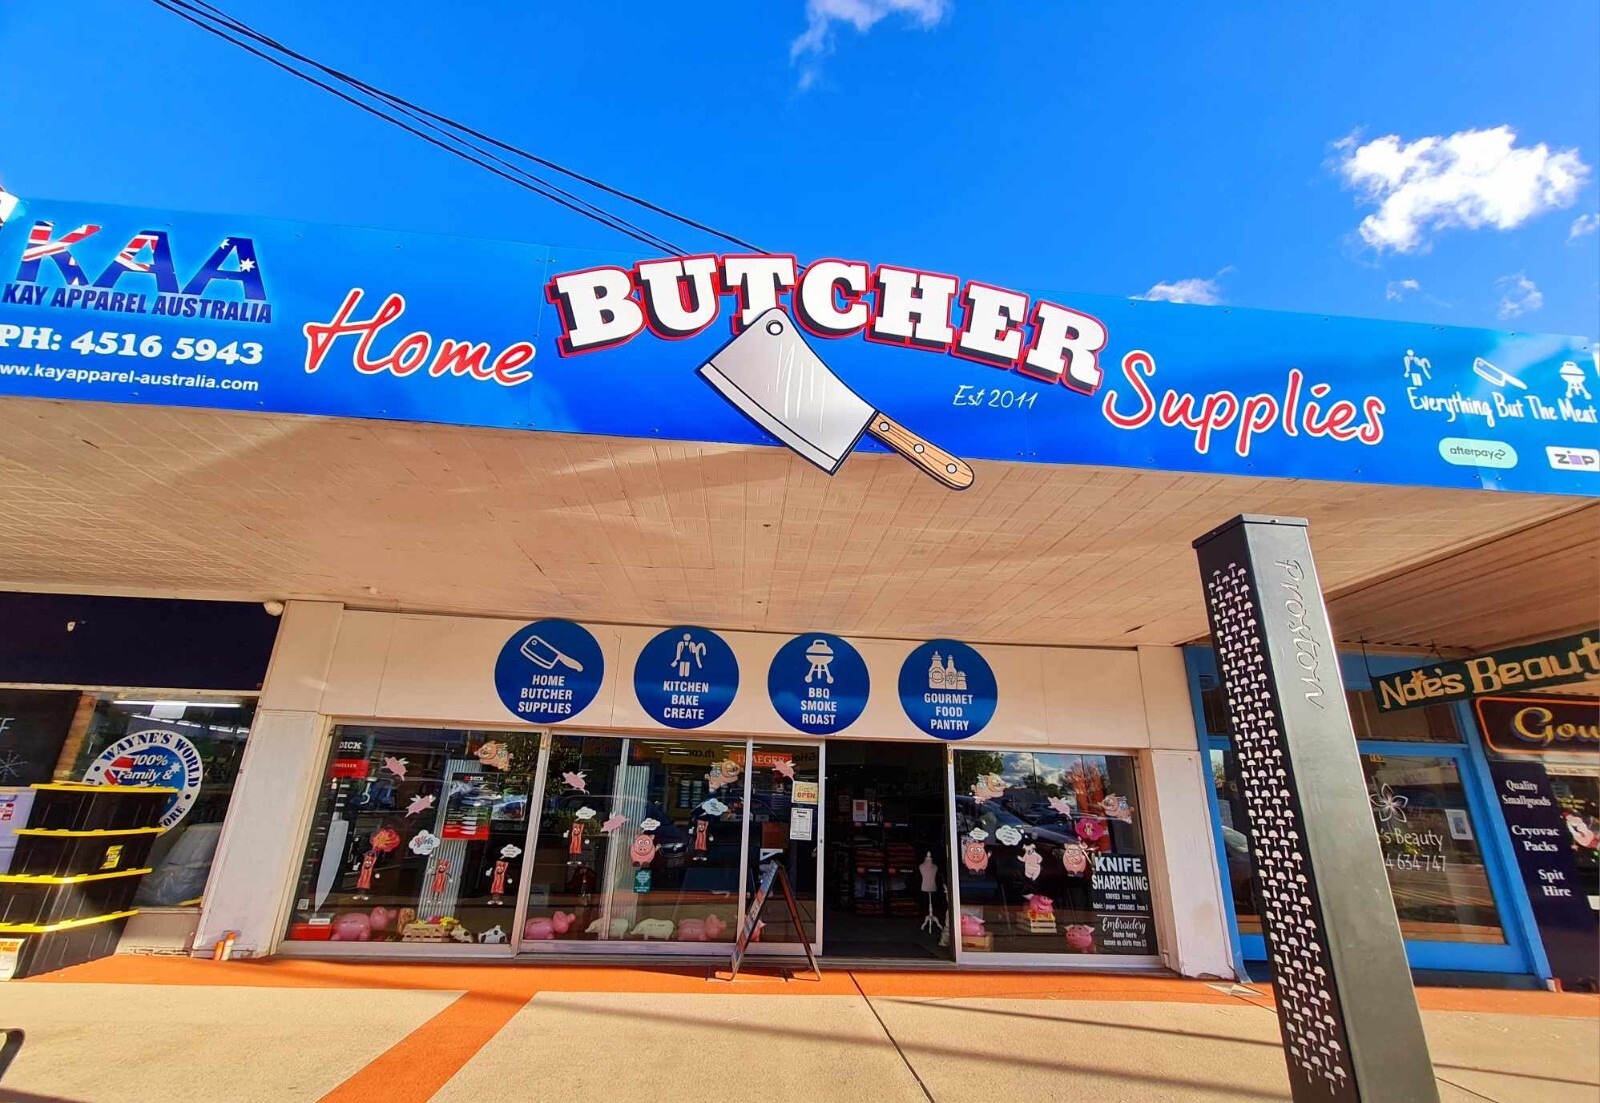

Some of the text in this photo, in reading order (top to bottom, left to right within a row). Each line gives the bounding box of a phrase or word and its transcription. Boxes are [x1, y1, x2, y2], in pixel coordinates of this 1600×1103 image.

[16, 220, 267, 300] KAA
[3, 284, 272, 324] KAY APPAREL AUSTRALIA
[0, 324, 263, 365] PH: 4516 5943
[303, 254, 1386, 457] Home BUTCHER Supplies
[953, 385, 1038, 409] Est 2011
[1407, 387, 1599, 428] Everything But The Meat
[1450, 446, 1495, 458] afterpay
[532, 674, 566, 687] HOME
[663, 680, 709, 693] KITCHEN
[520, 687, 572, 701] BUTCHER
[808, 687, 830, 700] BBQ
[1379, 667, 1465, 709] Nae's
[671, 694, 699, 706] BAKE
[923, 692, 974, 705] GOURMET
[518, 701, 572, 714] SUPPLIES
[800, 700, 837, 712] SMOKE
[935, 706, 963, 717] FOOD
[663, 707, 705, 720] CREATE
[801, 713, 836, 725] ROAST
[930, 719, 969, 731] PANTRY
[338, 741, 363, 749] DICK
[101, 732, 200, 788] WAYNE'S WORLD
[132, 754, 168, 766] 100%
[117, 769, 161, 780] Family
[1505, 780, 1538, 794] Quality
[796, 791, 816, 799] OPEN
[1502, 795, 1551, 808] Smallgoods
[1511, 825, 1560, 838] Cryovac
[1394, 827, 1443, 851] Beauty
[1523, 841, 1559, 852] Packs
[1095, 857, 1142, 873] KNIFE
[1397, 853, 1421, 871] 634
[1422, 855, 1446, 872] 747
[1091, 874, 1149, 891] SHARPENING
[1538, 869, 1565, 883] Spit
[1541, 885, 1572, 897] Hire
[1102, 916, 1147, 935] Embroidery
